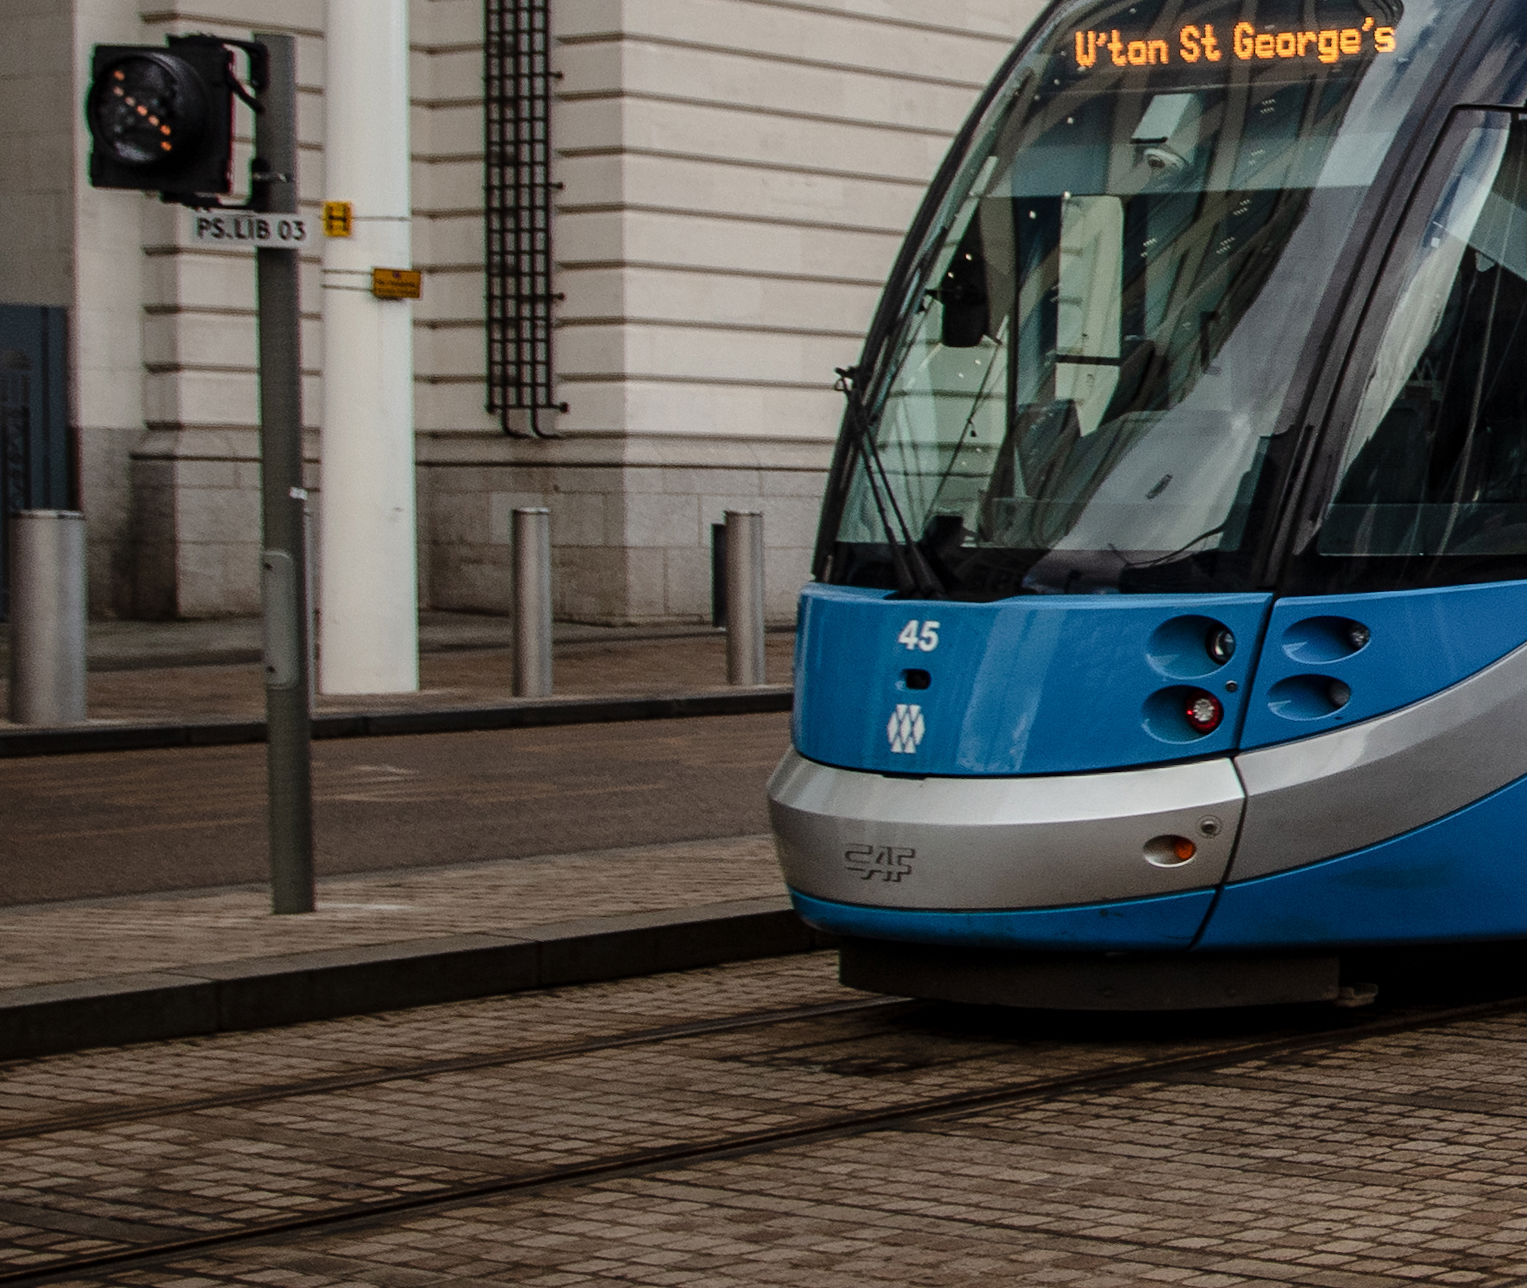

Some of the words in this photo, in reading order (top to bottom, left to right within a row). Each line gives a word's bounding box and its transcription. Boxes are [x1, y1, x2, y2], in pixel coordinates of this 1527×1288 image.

[1179, 23, 1222, 62] St
[1232, 16, 1396, 64] George's
[197, 217, 270, 239] PS.LIB
[278, 220, 306, 240] 03
[899, 620, 940, 652] 45
